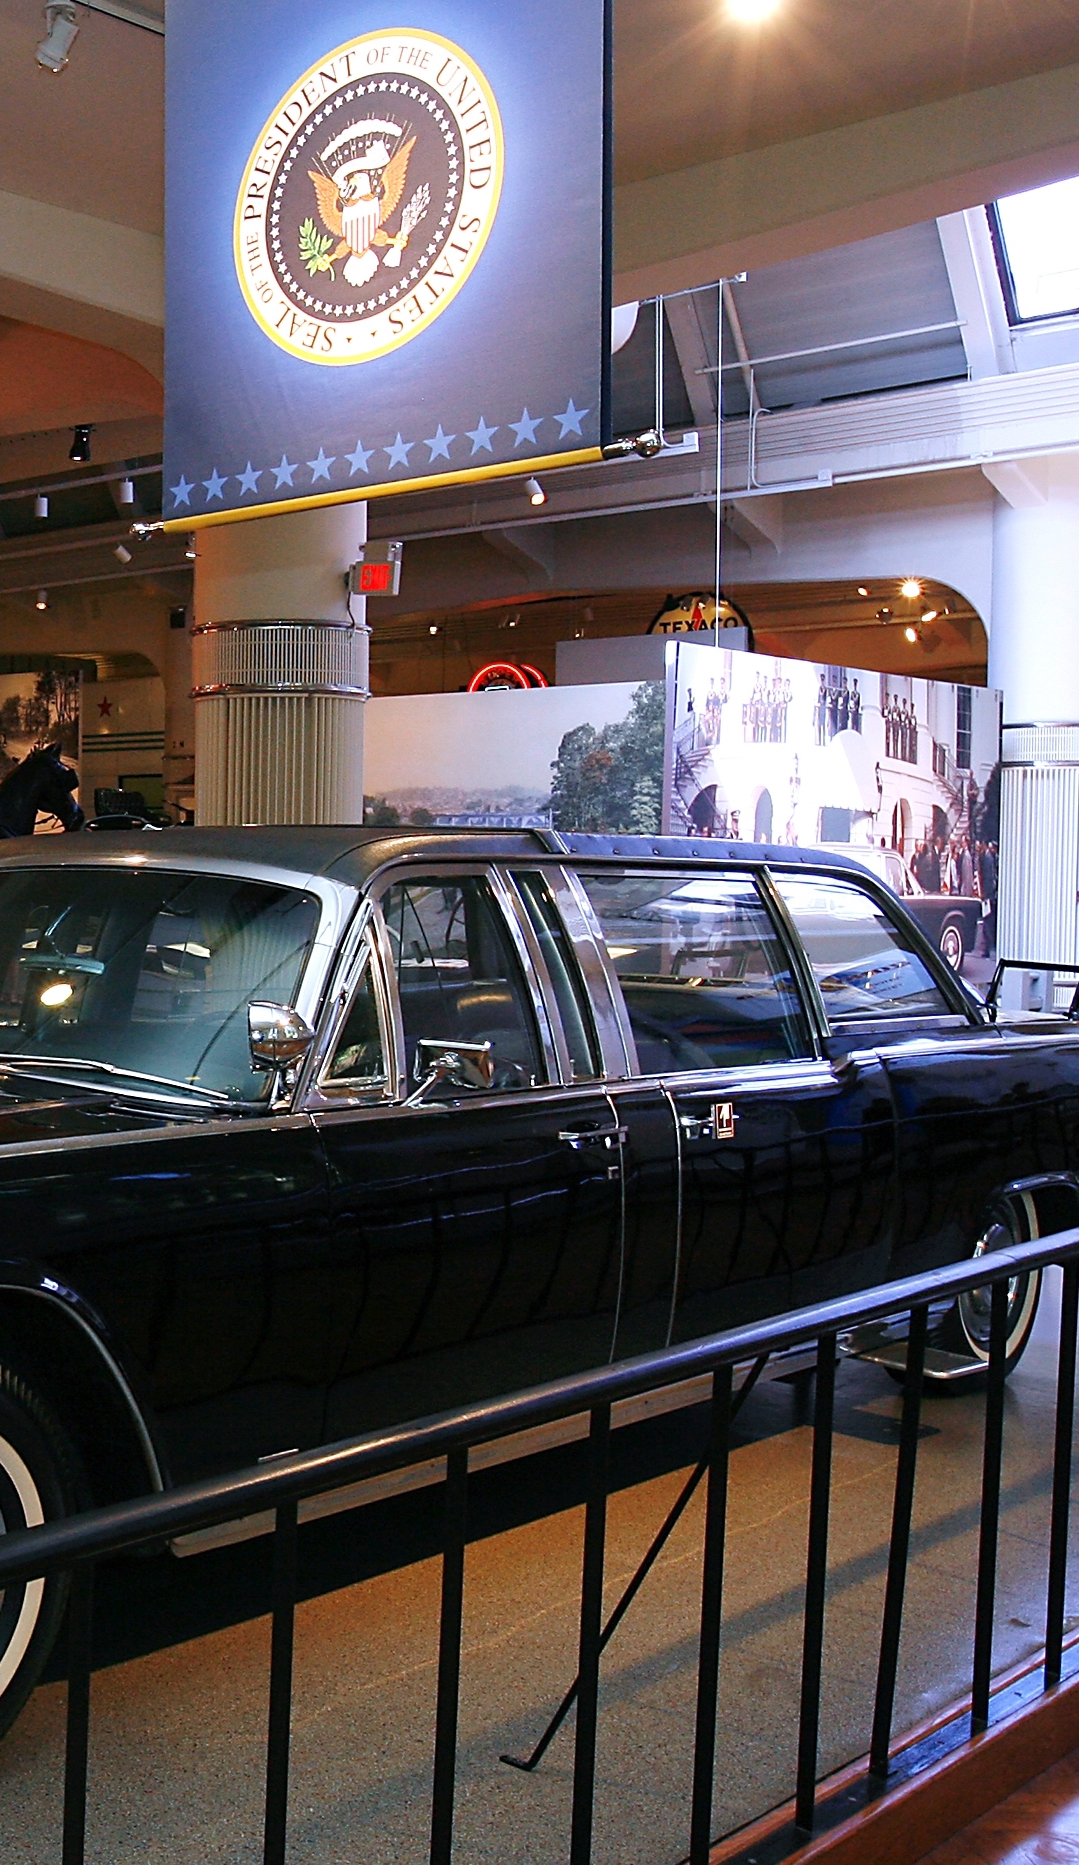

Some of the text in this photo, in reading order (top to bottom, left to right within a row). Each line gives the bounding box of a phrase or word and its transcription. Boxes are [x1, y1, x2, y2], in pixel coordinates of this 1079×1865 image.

[244, 46, 492, 352] SEAL OF THE PRESIDENT OF THE UNITED STATES
[360, 564, 393, 591] EXIT
